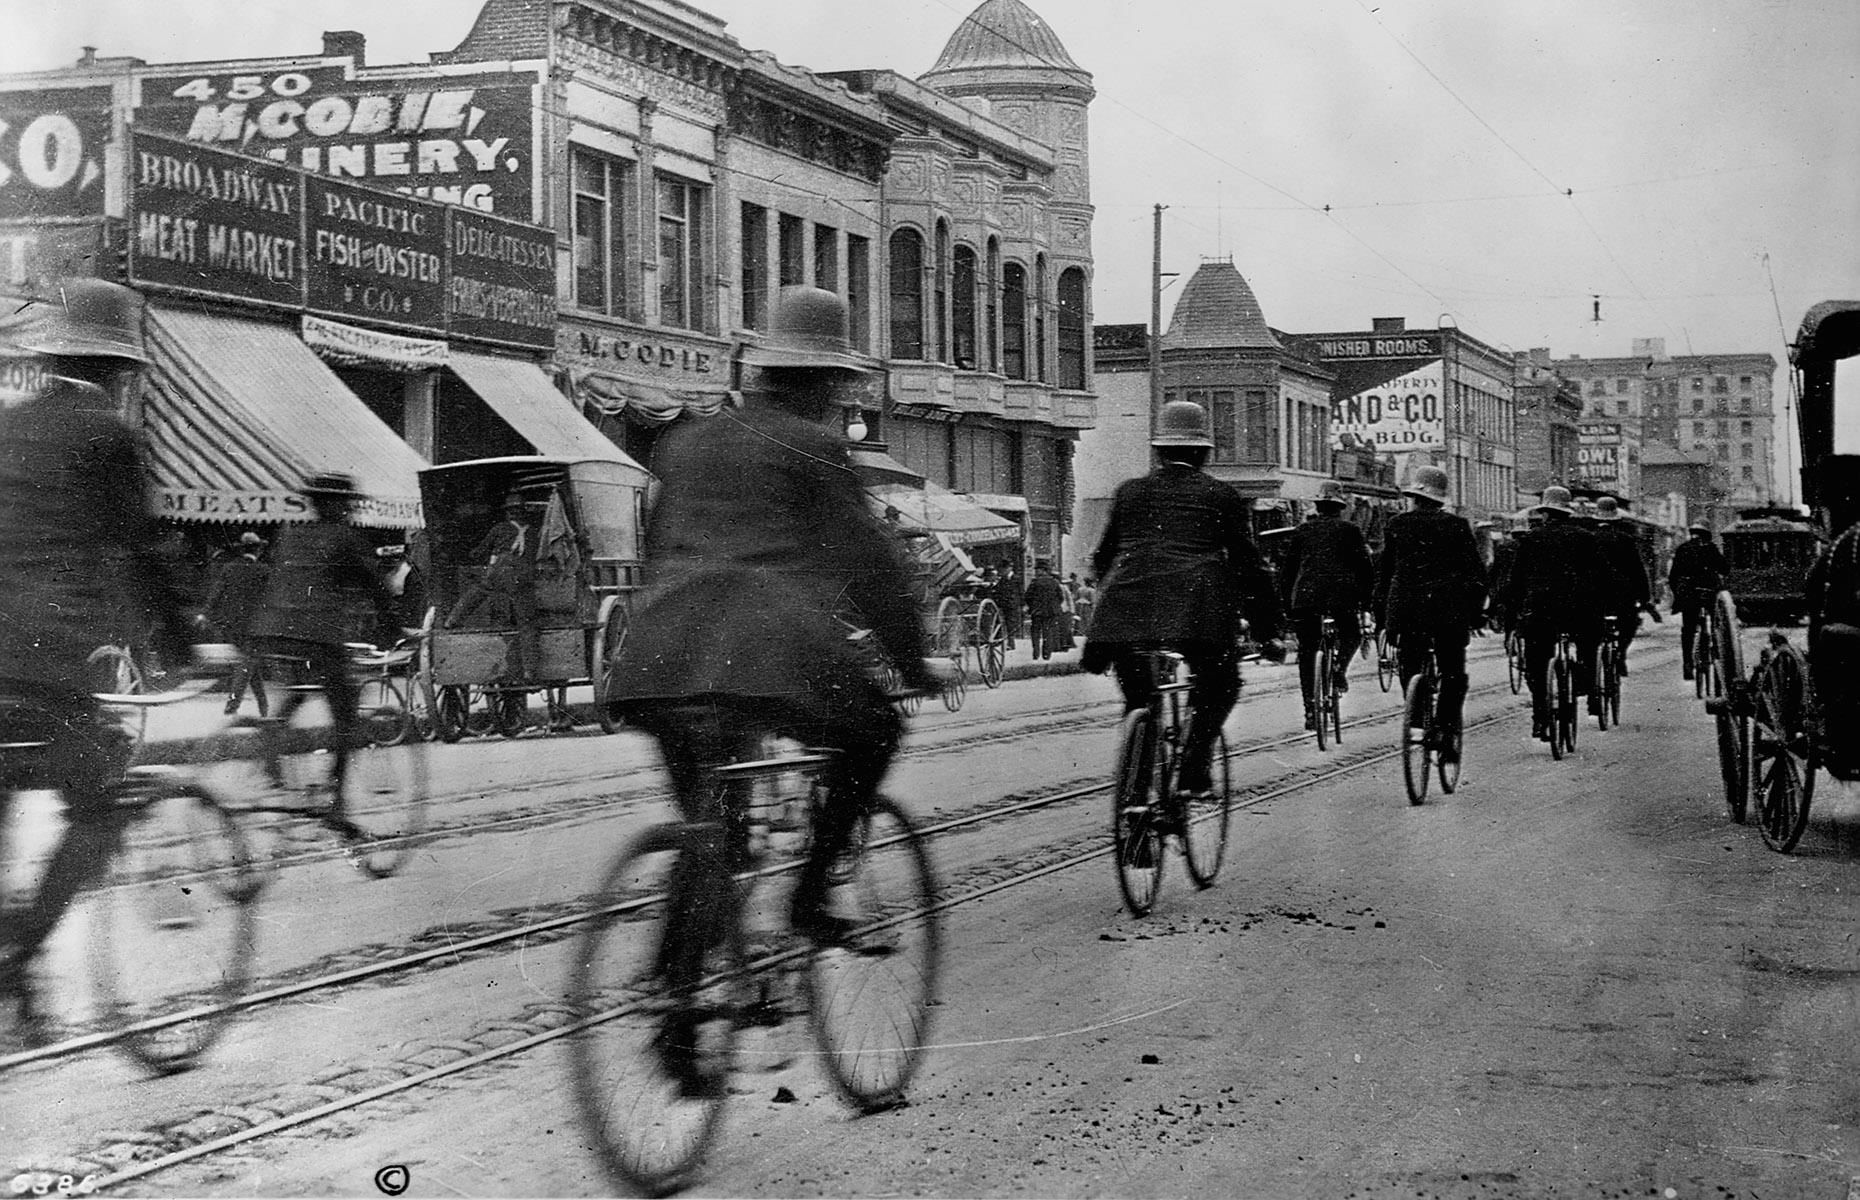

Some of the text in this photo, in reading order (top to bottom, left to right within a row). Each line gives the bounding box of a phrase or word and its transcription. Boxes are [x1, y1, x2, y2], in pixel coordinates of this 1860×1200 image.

[173, 73, 313, 101] 450
[140, 151, 295, 215] BROADWAY
[323, 192, 425, 235] PACIFIC
[139, 211, 295, 279] MEAT MARKET
[316, 229, 361, 268] FISH
[374, 243, 441, 283] OYSTER
[1404, 393, 1442, 423] CO.
[1376, 431, 1440, 444] BLDG.
[1578, 448, 1616, 464] OWL
[162, 493, 310, 513] MEATS
